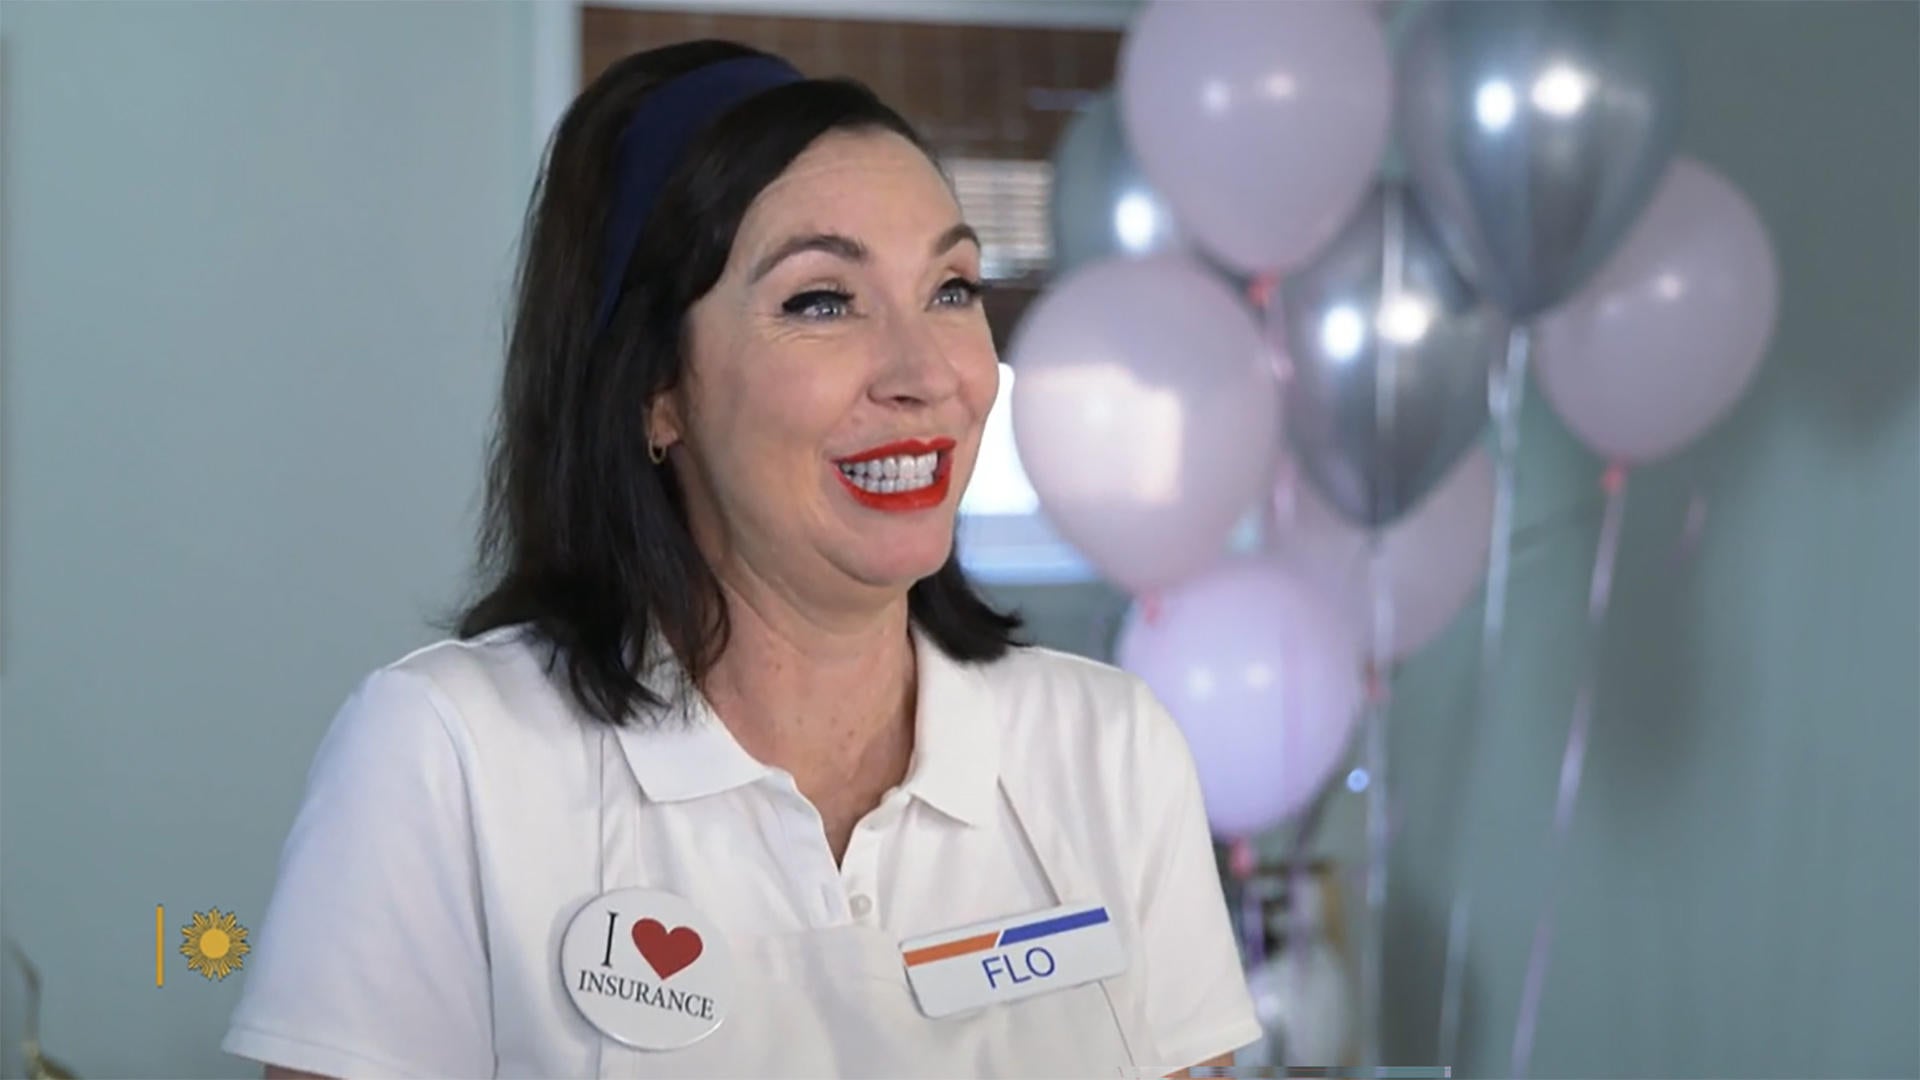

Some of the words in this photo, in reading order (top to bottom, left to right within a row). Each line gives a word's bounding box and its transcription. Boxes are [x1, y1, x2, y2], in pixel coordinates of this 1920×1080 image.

[601, 911, 619, 968] I
[981, 947, 1055, 989] FLO
[578, 969, 714, 1020] INSURANCE
